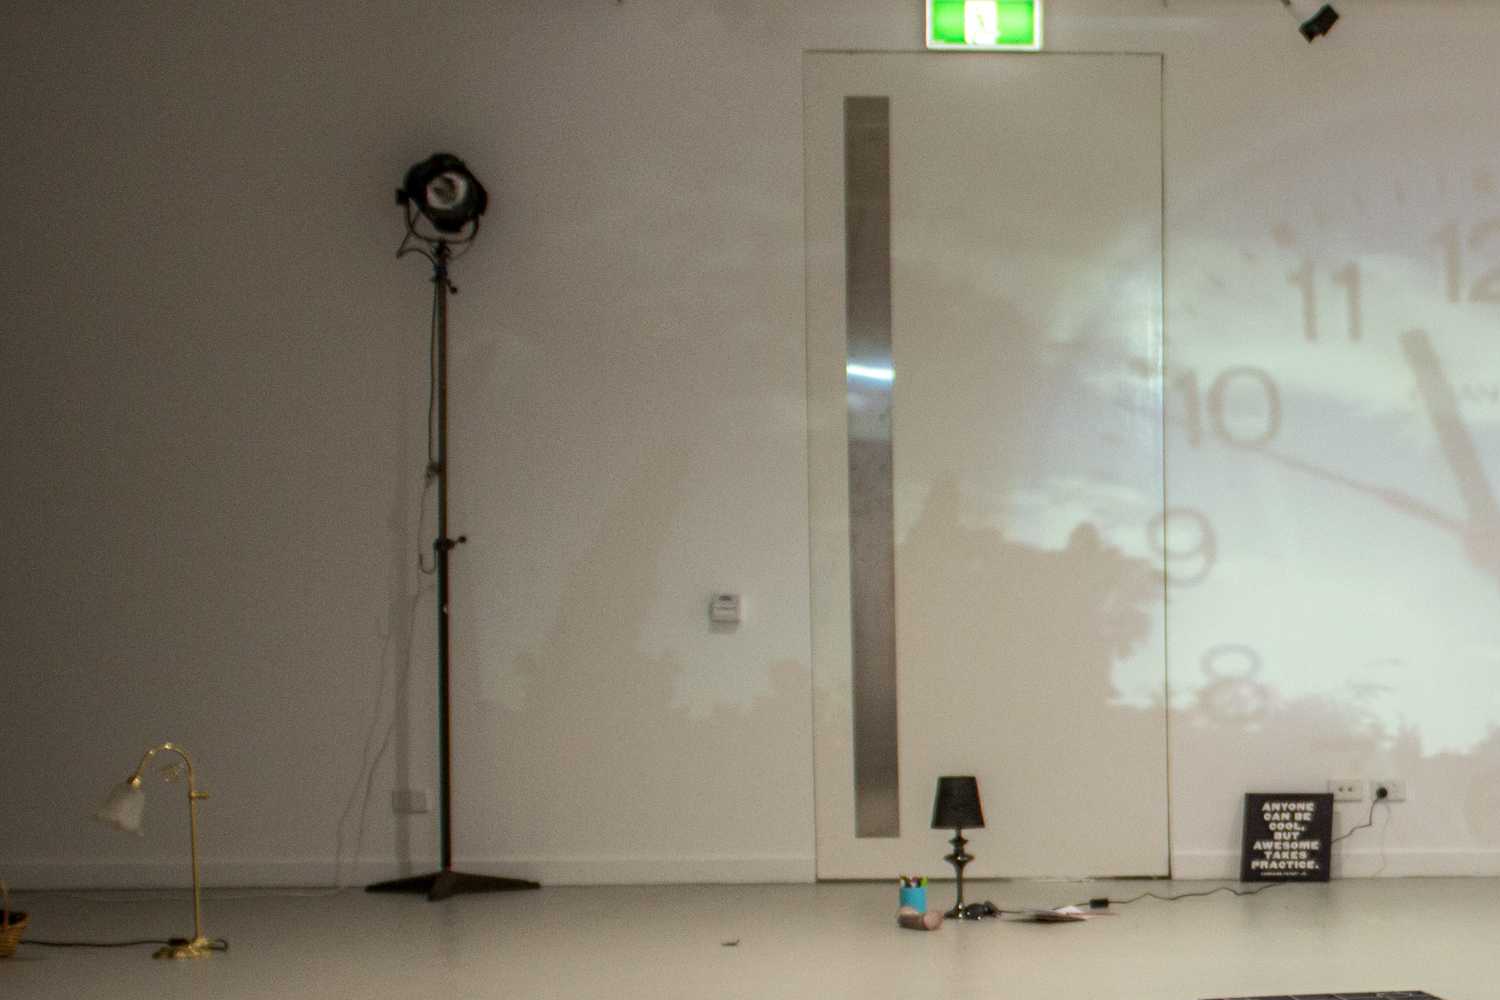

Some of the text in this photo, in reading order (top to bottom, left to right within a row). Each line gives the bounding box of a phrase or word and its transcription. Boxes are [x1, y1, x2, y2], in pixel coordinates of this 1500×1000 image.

[1286, 258, 1363, 342] 11
[1171, 364, 1284, 451] 10
[1146, 505, 1219, 588] 9
[1198, 642, 1270, 725] 8
[1261, 801, 1315, 812] ANYONE
[1263, 812, 1312, 821] CAN BE
[1273, 831, 1300, 840] BUT
[1252, 840, 1320, 850] AWESOME
[1263, 850, 1308, 860] TAKES
[1250, 859, 1320, 870] PRACTICE.
